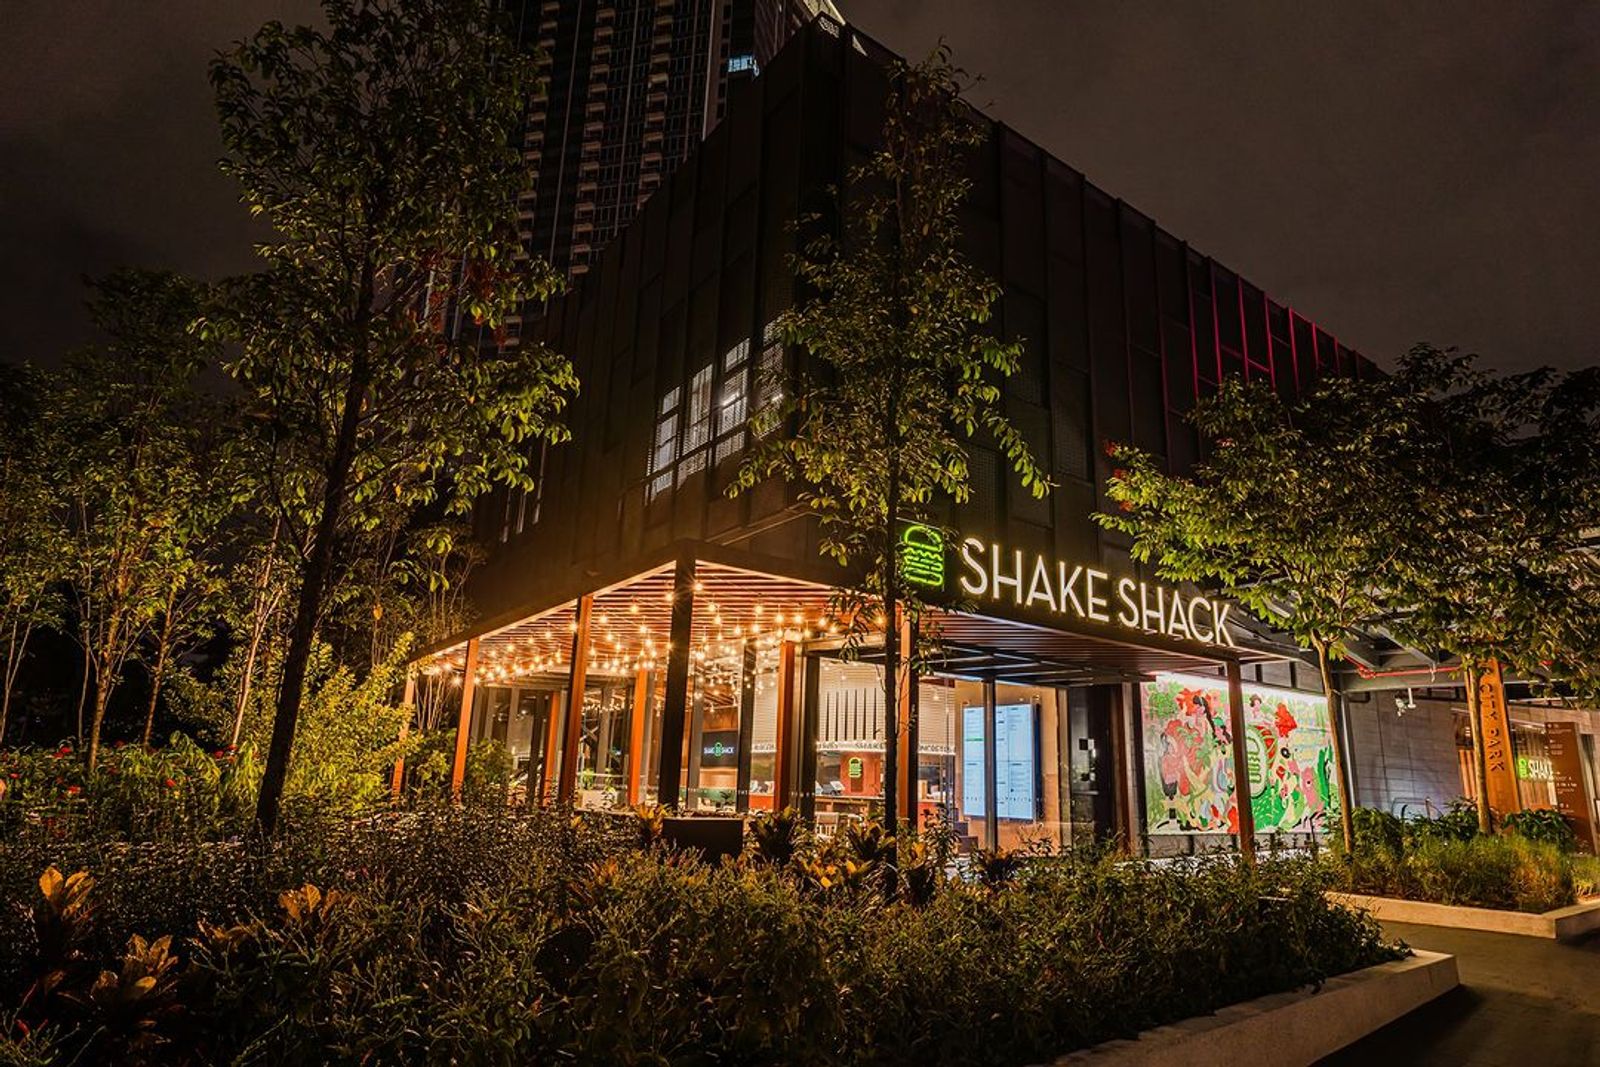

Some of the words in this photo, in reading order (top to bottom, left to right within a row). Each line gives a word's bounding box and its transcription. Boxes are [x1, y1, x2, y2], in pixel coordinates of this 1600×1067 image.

[960, 537, 1110, 622] SHAKE
[1118, 578, 1235, 647] SHACK
[1488, 728, 1505, 772] PARK
